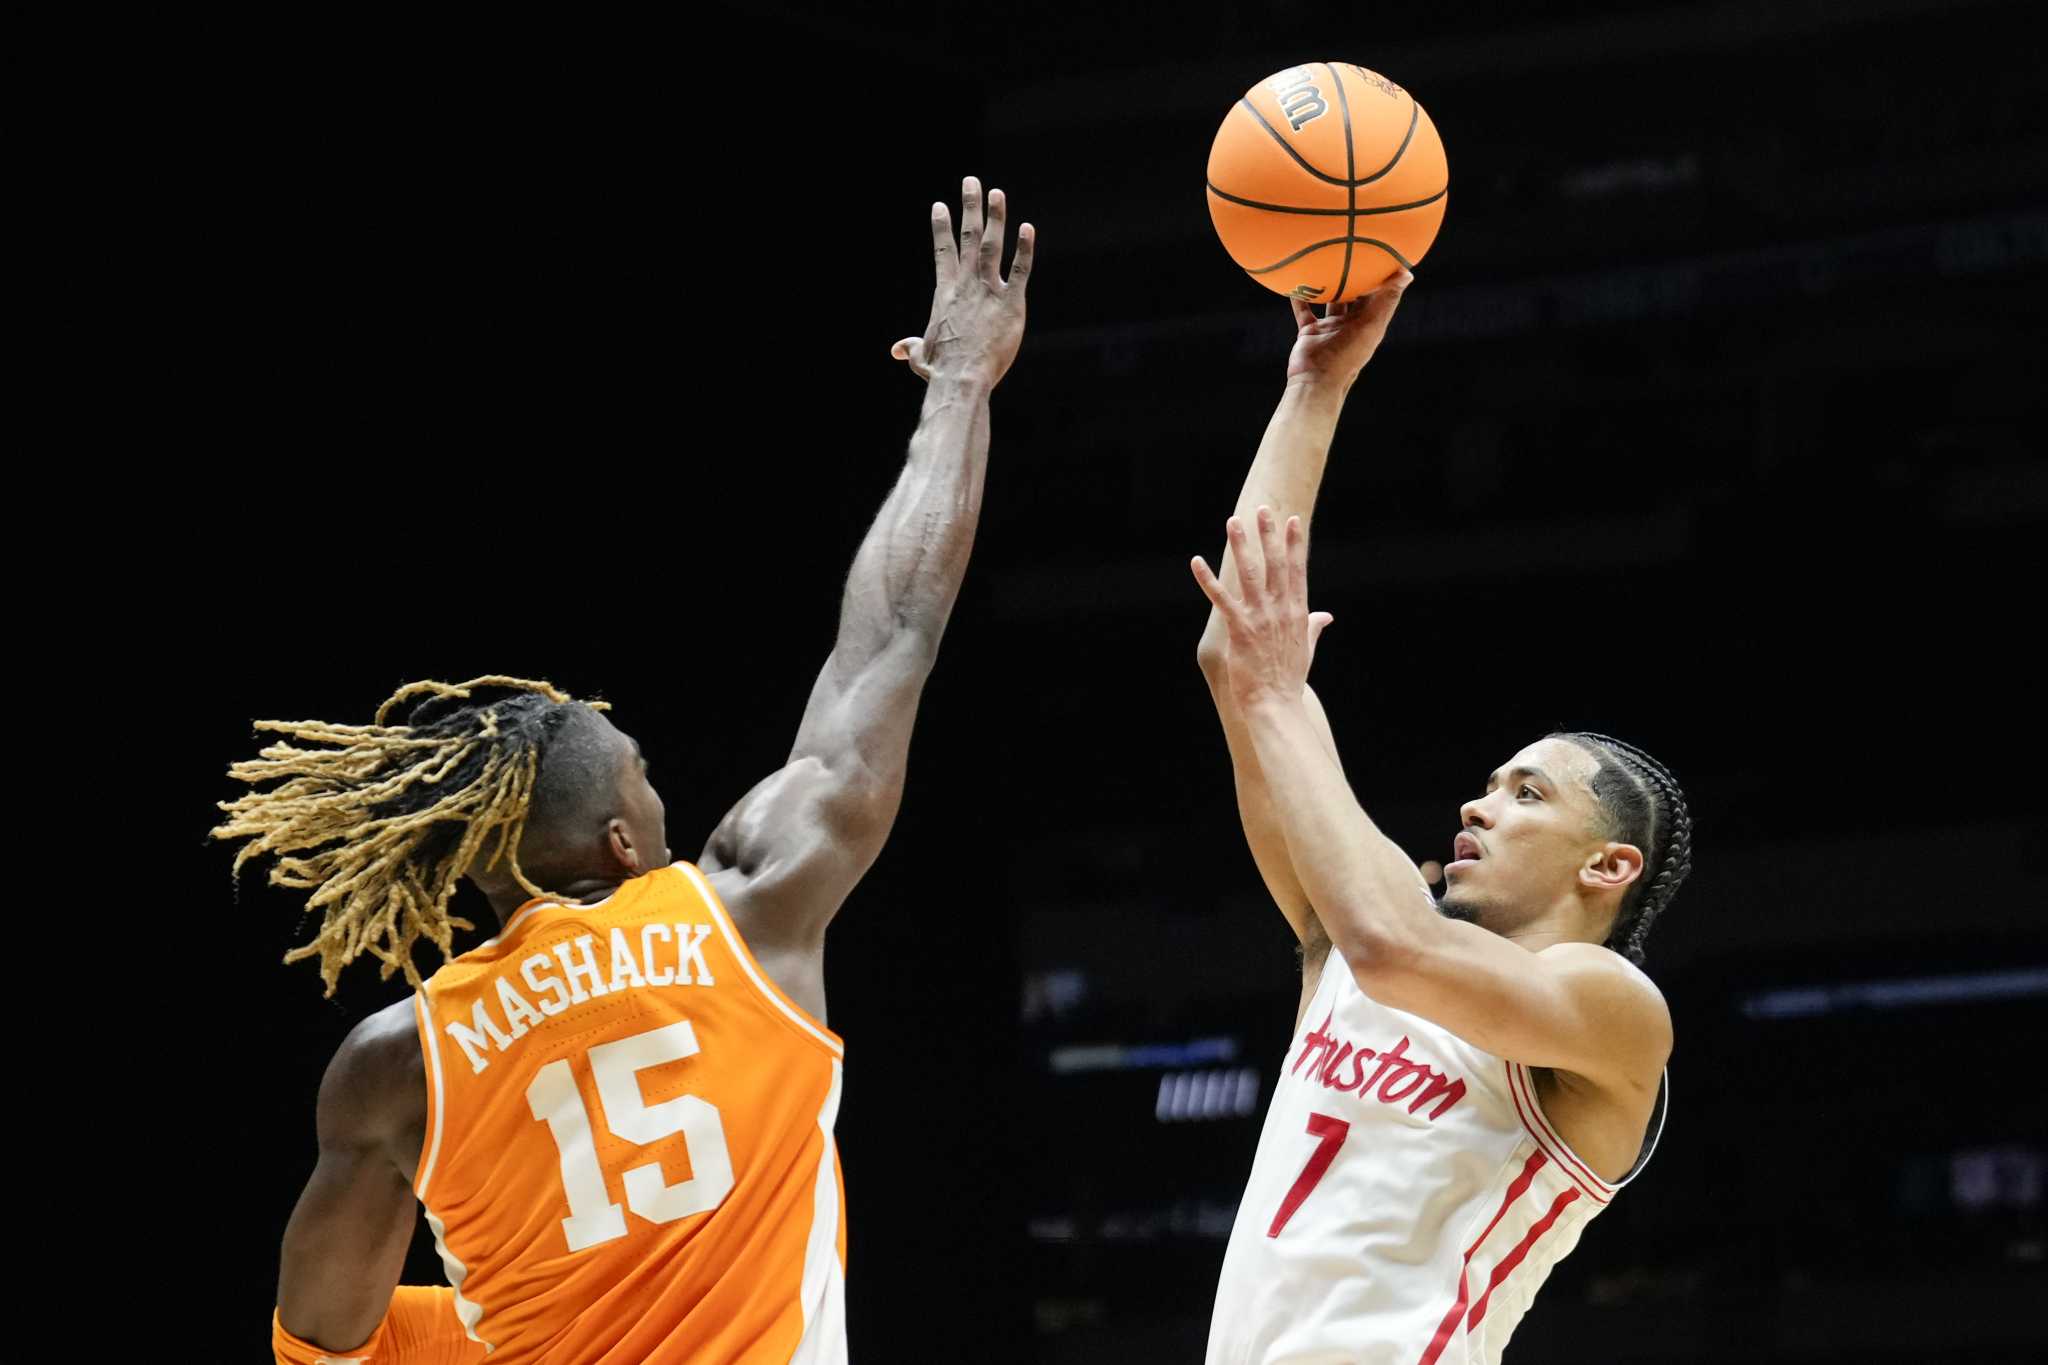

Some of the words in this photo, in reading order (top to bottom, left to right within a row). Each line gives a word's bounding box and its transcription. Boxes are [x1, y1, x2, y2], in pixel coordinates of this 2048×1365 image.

[446, 924, 716, 1075] MASHACK
[525, 1020, 735, 1252] 15
[1266, 1112, 1351, 1239] 7
